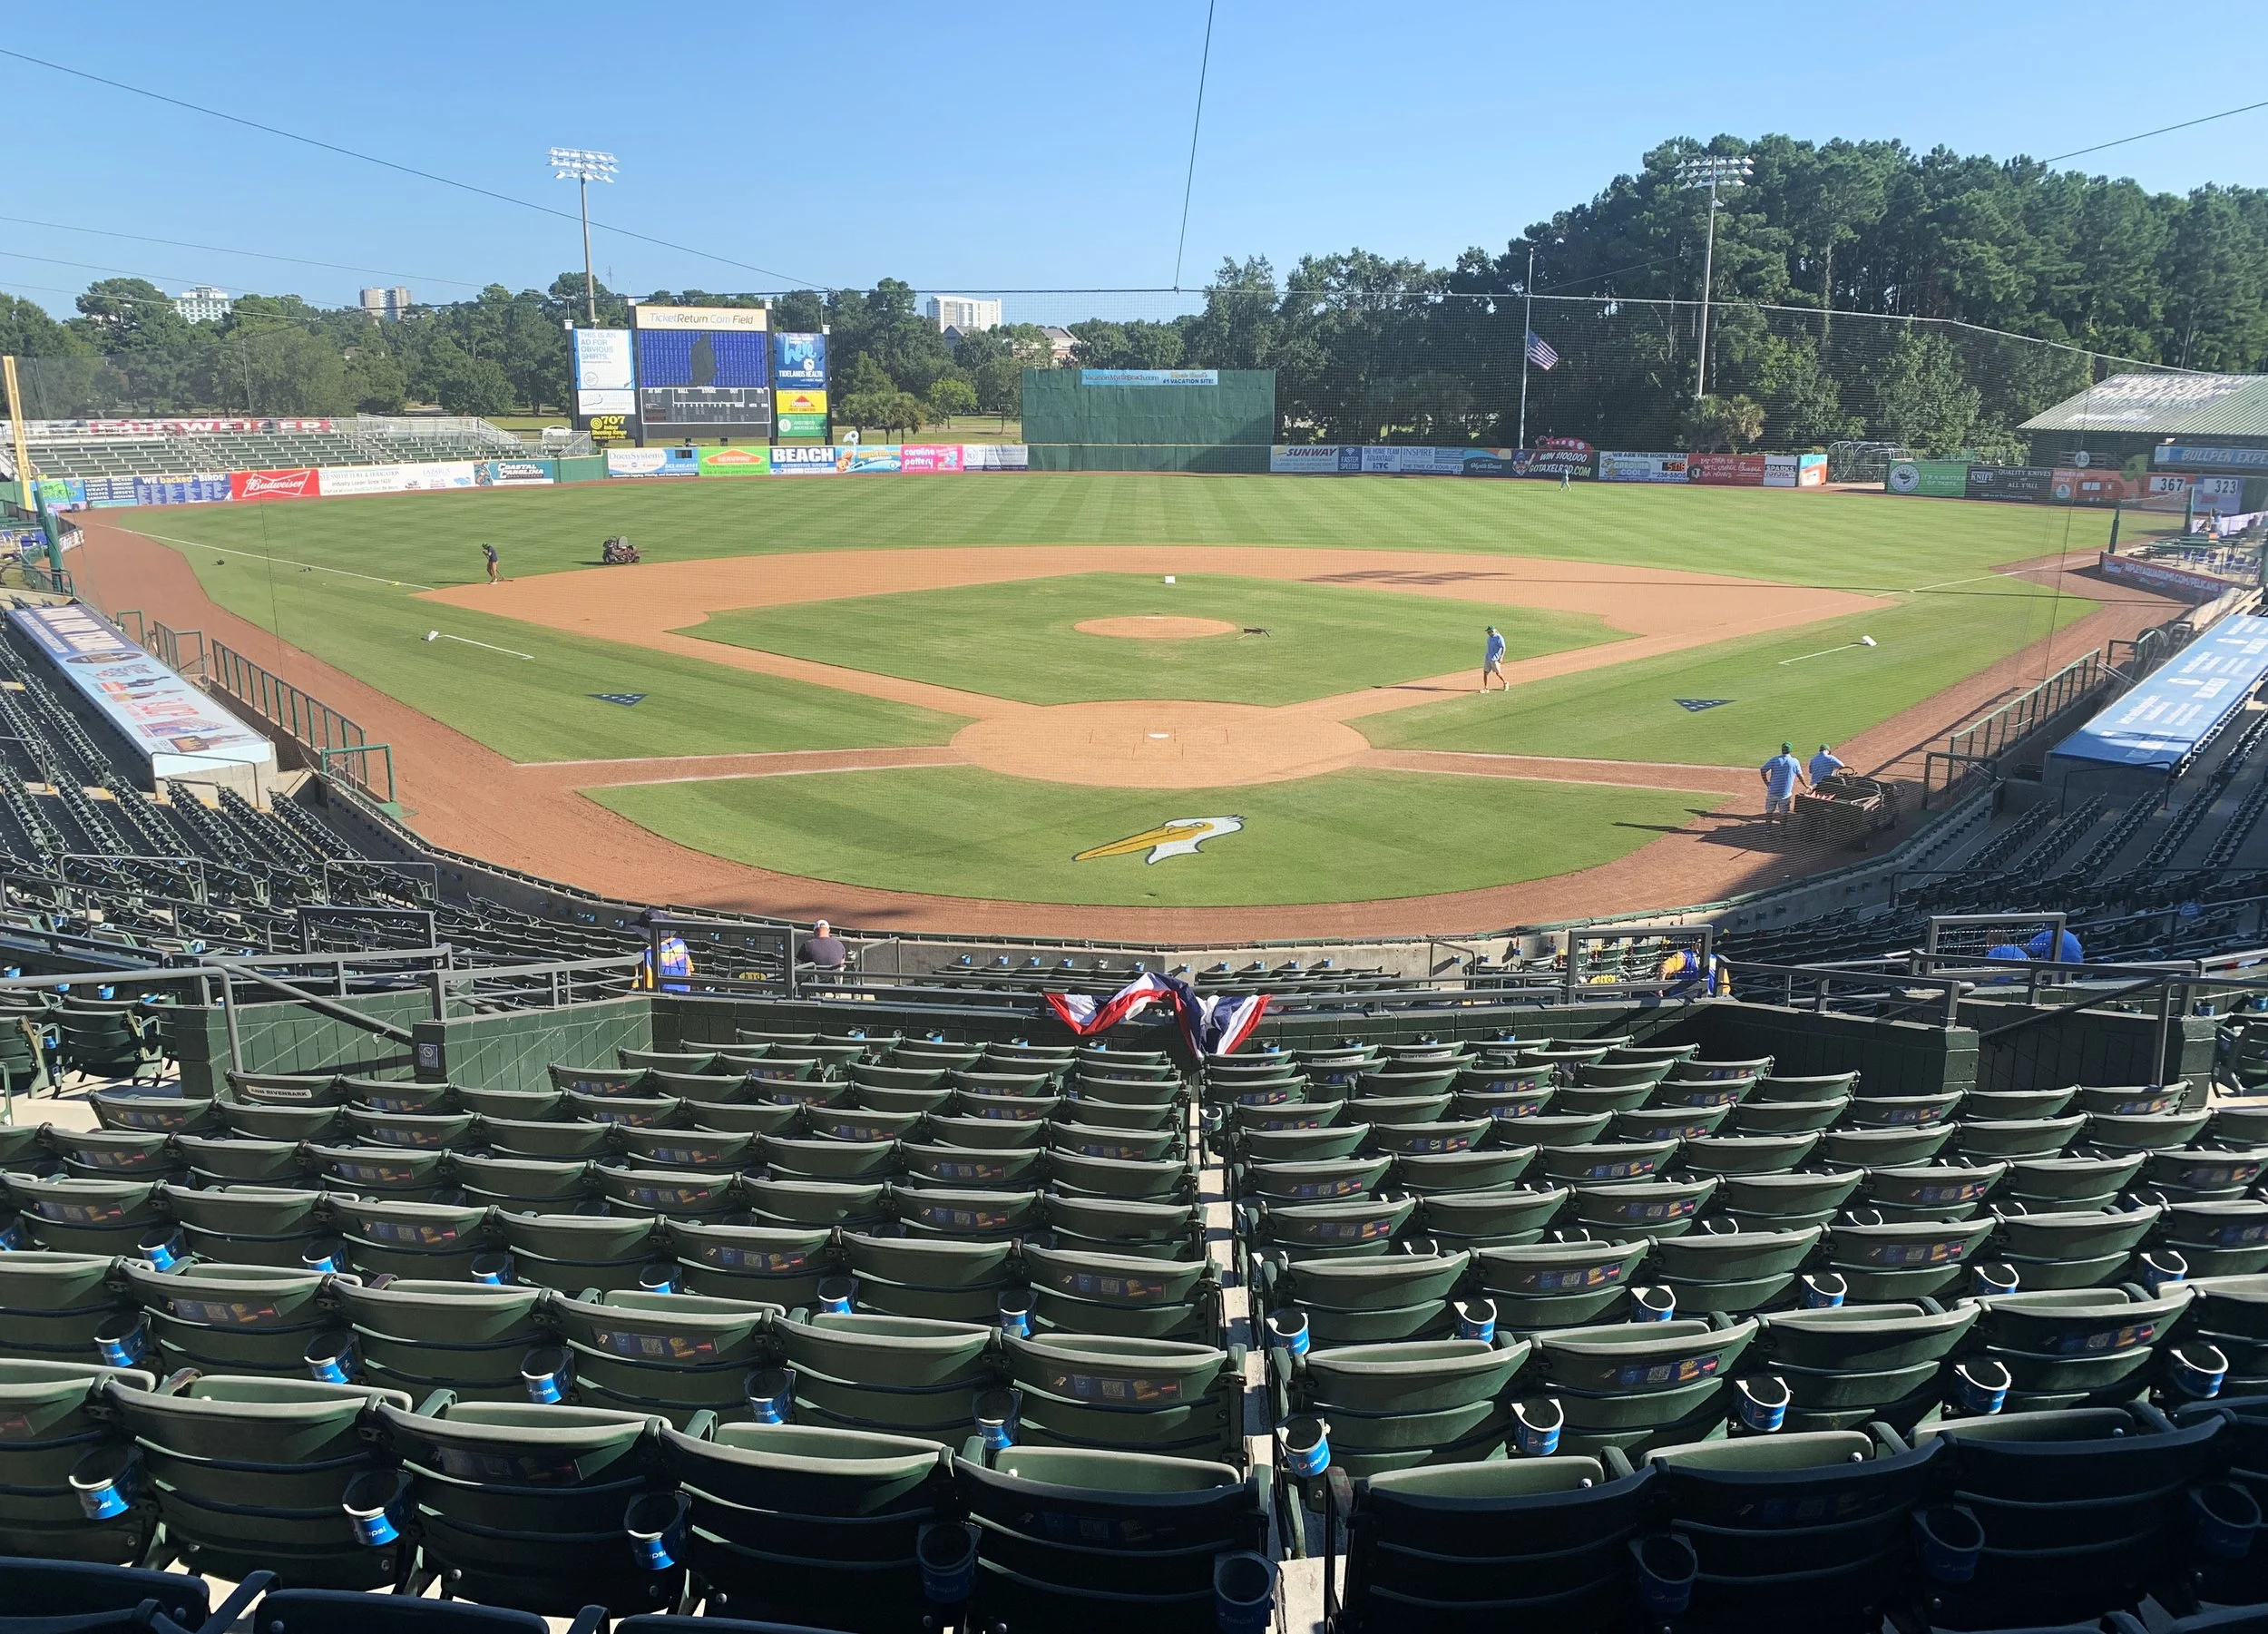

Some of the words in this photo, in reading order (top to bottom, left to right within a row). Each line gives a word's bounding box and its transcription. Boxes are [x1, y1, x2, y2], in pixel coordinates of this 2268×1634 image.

[733, 315, 753, 324] Field
[601, 416, 626, 425] 707
[610, 452, 664, 461] DocuSystems
[772, 448, 834, 463] BEACH
[904, 447, 935, 455] carolina
[1286, 448, 1337, 456] SUNWAY
[2182, 450, 2232, 462] BULLPEN
[904, 457, 933, 469] pottery
[1540, 453, 1555, 461] WIN
[1555, 452, 1588, 463] $100,000
[498, 463, 537, 472] COASTAL
[500, 469, 544, 479] CAROLINA
[247, 478, 305, 491] Budweiser
[2160, 477, 2184, 492] 367
[2214, 480, 2237, 494] 323
[533, 1387, 555, 1399] pepsi
[1309, 1452, 1328, 1468] pepsi
